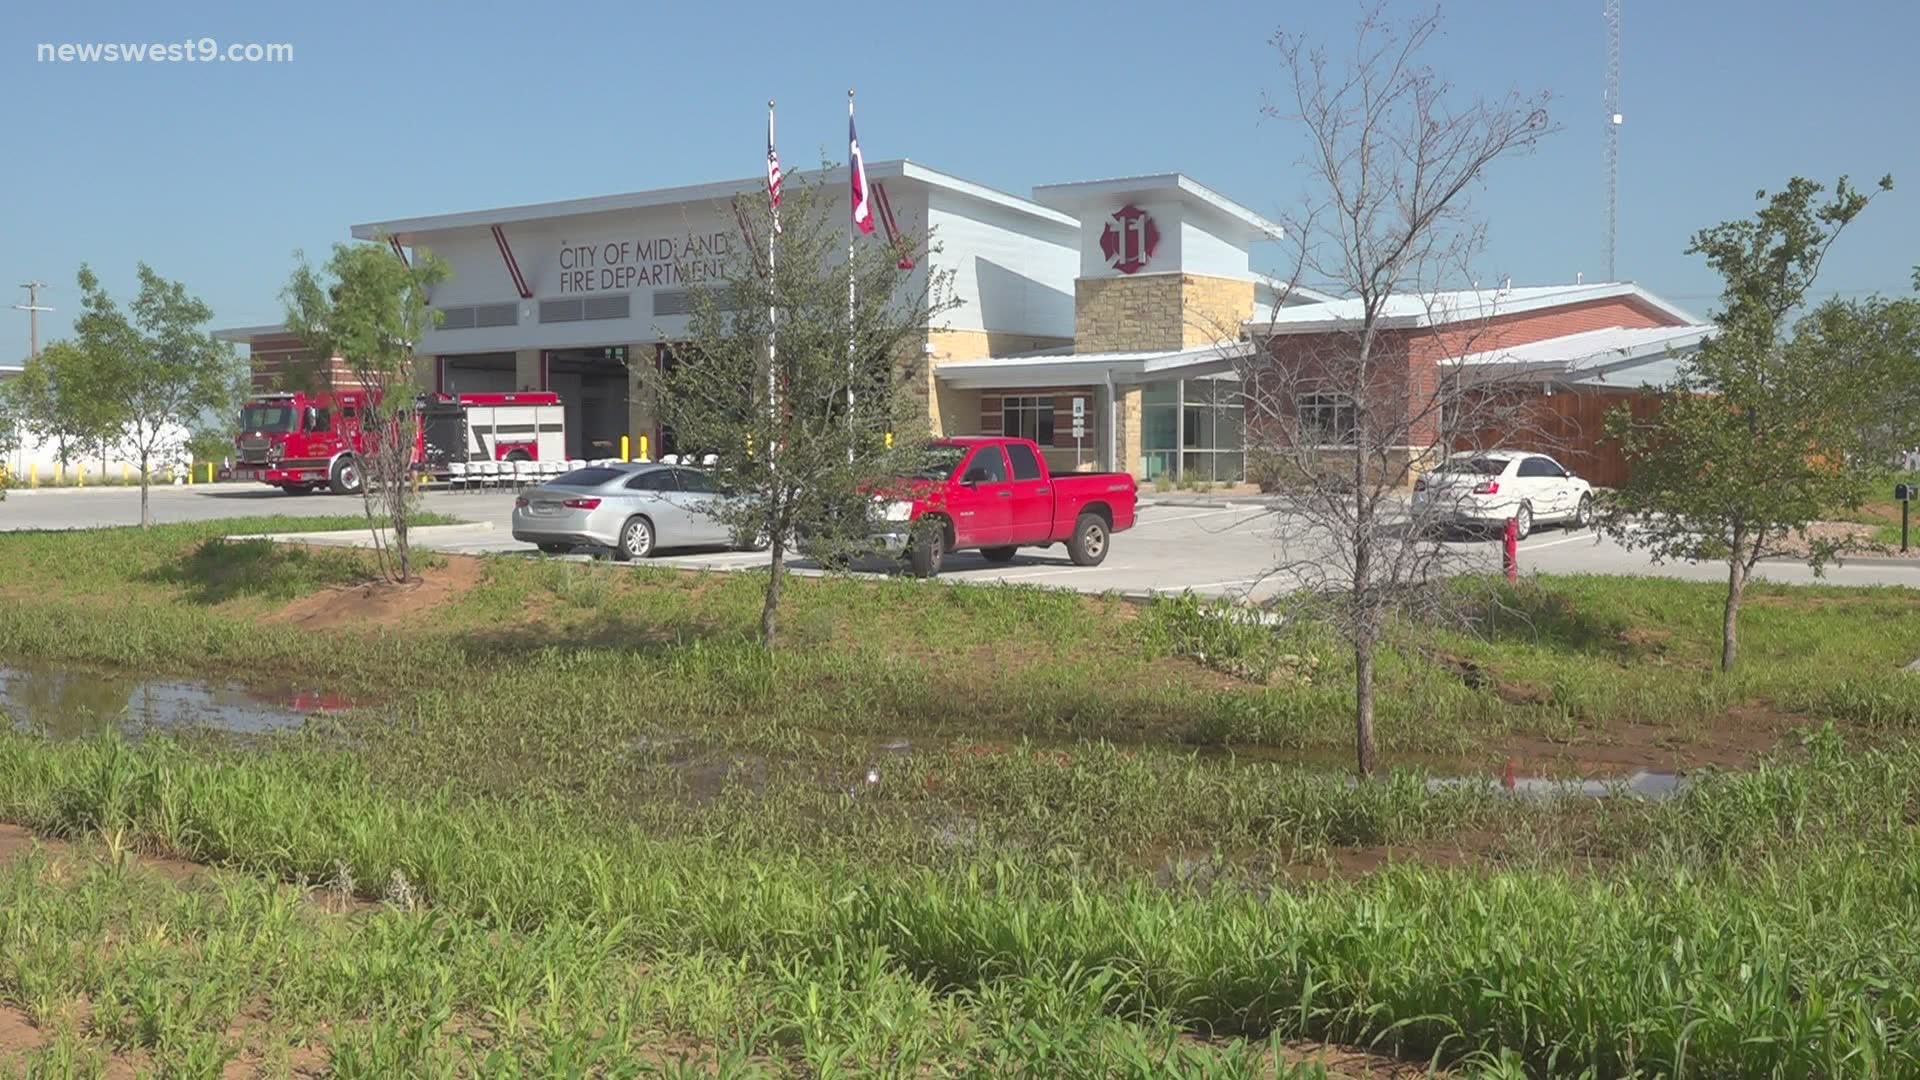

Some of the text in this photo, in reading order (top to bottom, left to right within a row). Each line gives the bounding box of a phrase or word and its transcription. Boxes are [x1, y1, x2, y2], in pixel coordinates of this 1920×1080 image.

[560, 246, 597, 270] CITY
[603, 242, 630, 266] OF
[1110, 215, 1146, 264] 11
[560, 259, 726, 293] FIRE DEPARTMENT
